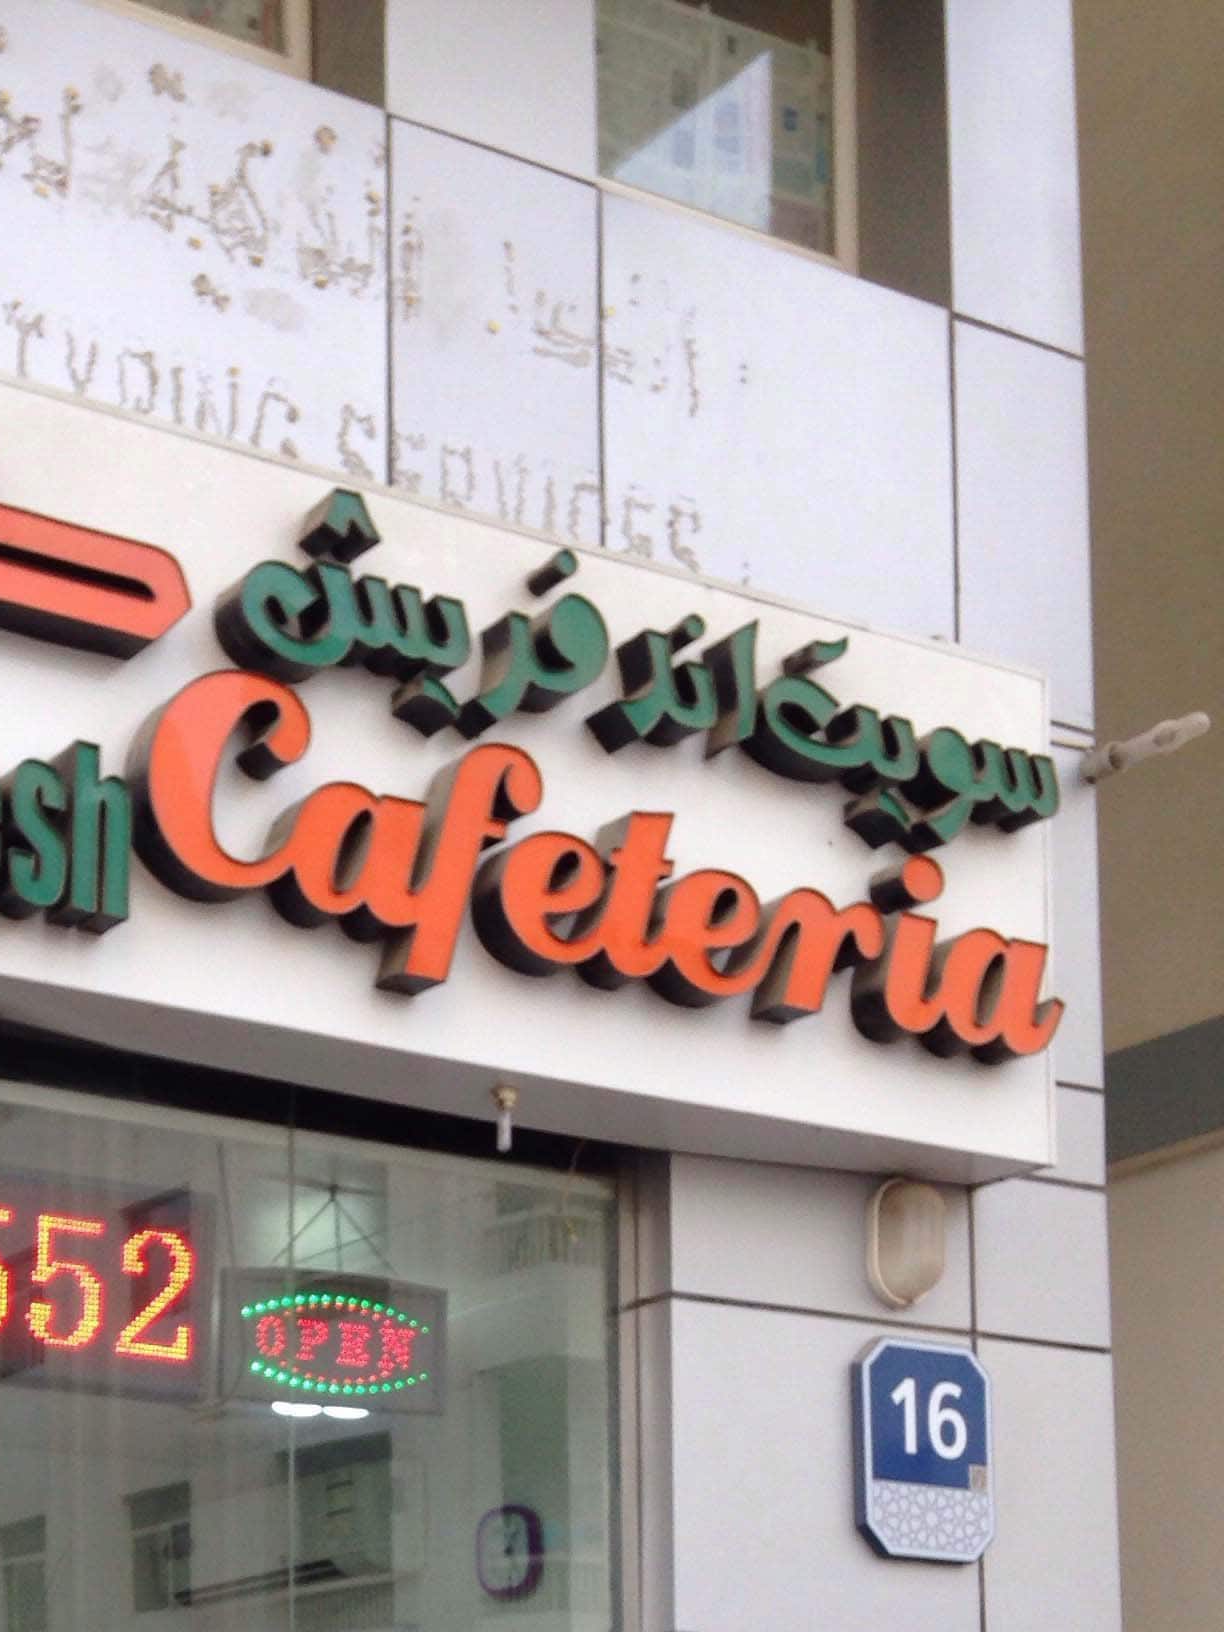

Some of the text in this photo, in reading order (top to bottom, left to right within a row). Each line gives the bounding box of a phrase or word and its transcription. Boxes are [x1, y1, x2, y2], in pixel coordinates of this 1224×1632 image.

[215, 487, 609, 740] فريش
[586, 614, 760, 760] اند
[758, 636, 1061, 853] سويت
[128, 670, 1065, 1067] Cafeteria
[253, 1311, 417, 1376] OPEN
[890, 1377, 968, 1461] 16
